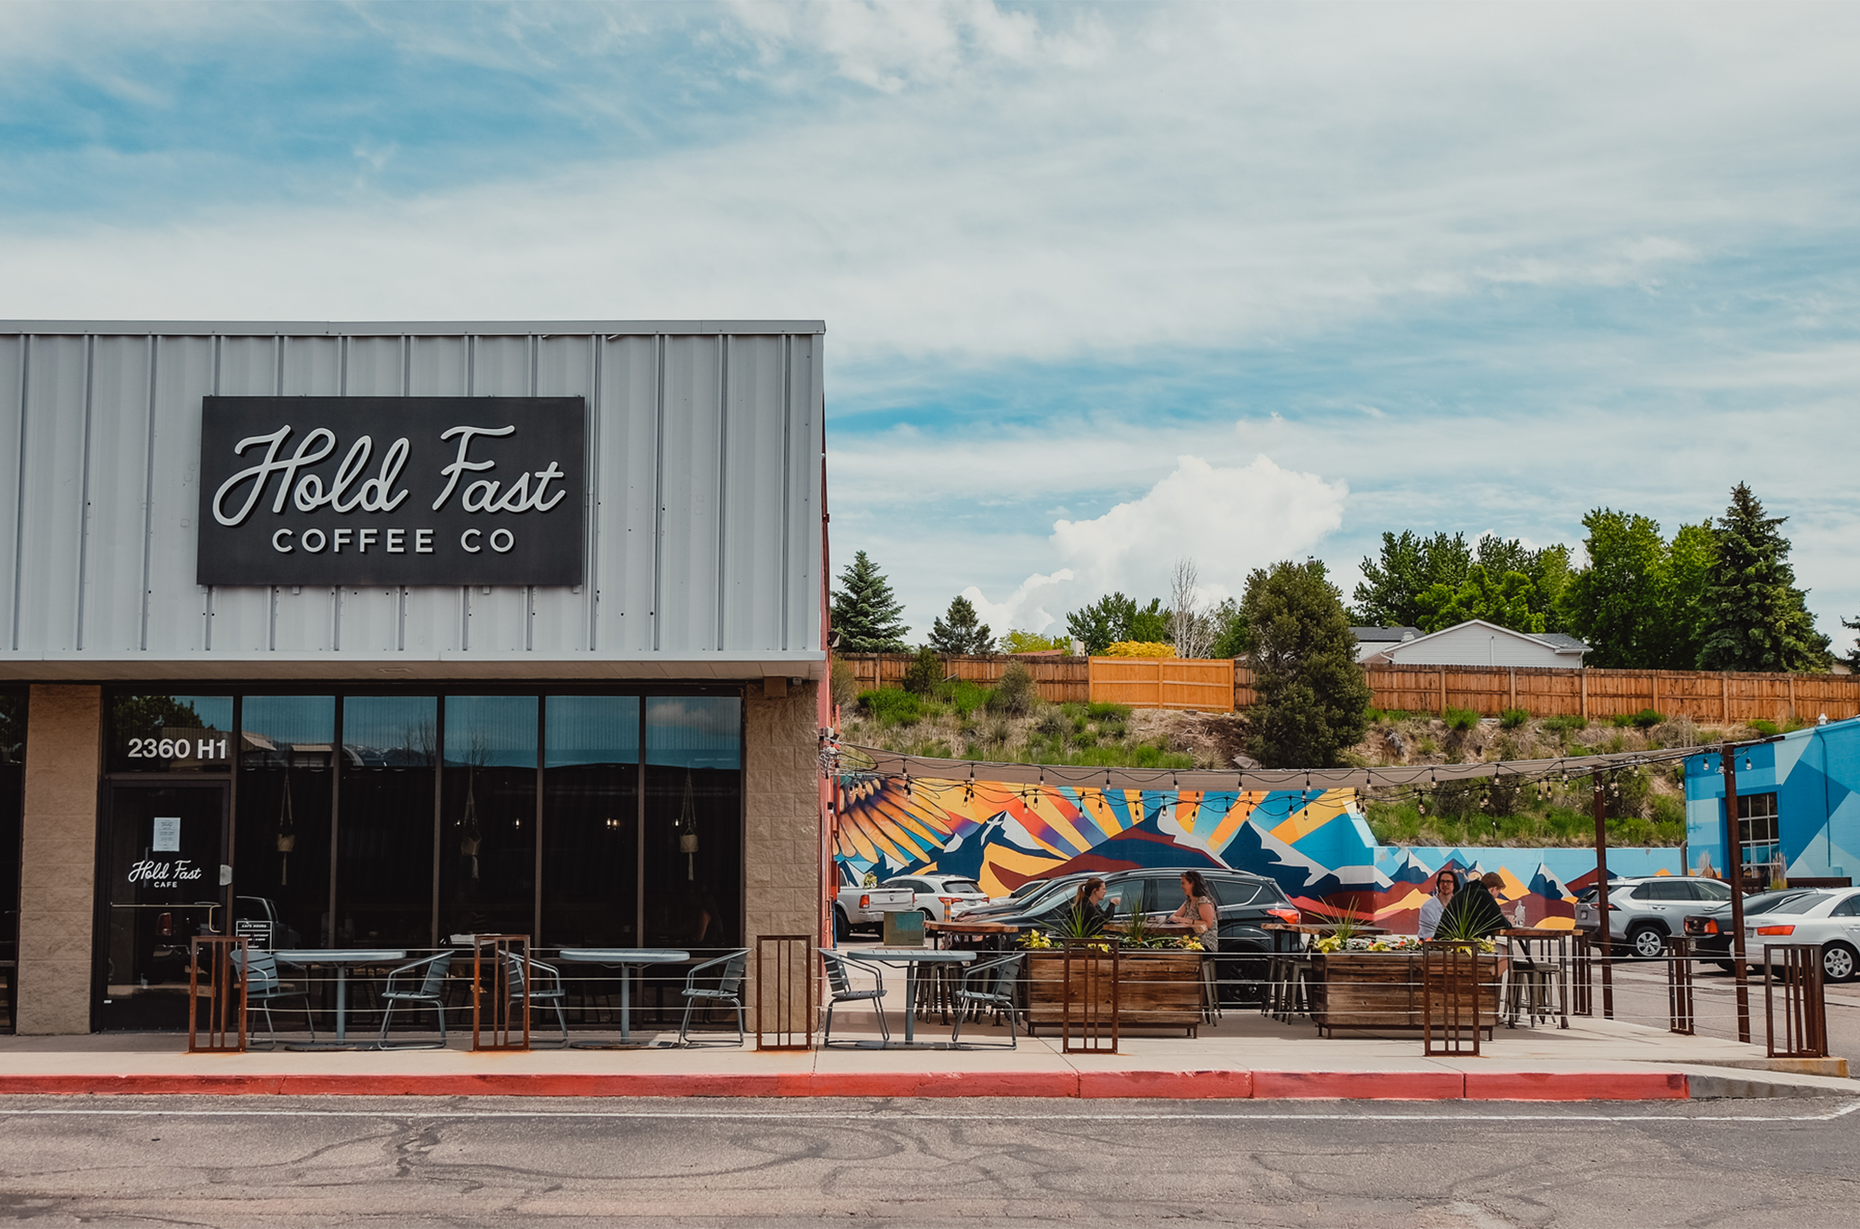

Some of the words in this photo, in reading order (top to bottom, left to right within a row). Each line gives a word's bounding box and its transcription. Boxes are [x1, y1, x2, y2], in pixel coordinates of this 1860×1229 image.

[213, 424, 411, 526] Hold
[432, 425, 566, 513] Fast
[272, 528, 435, 553] COFFEE
[460, 528, 516, 553] CO
[127, 738, 191, 759] 2360
[197, 739, 226, 759] H1
[128, 860, 169, 882] Hold
[173, 860, 202, 880] Fast
